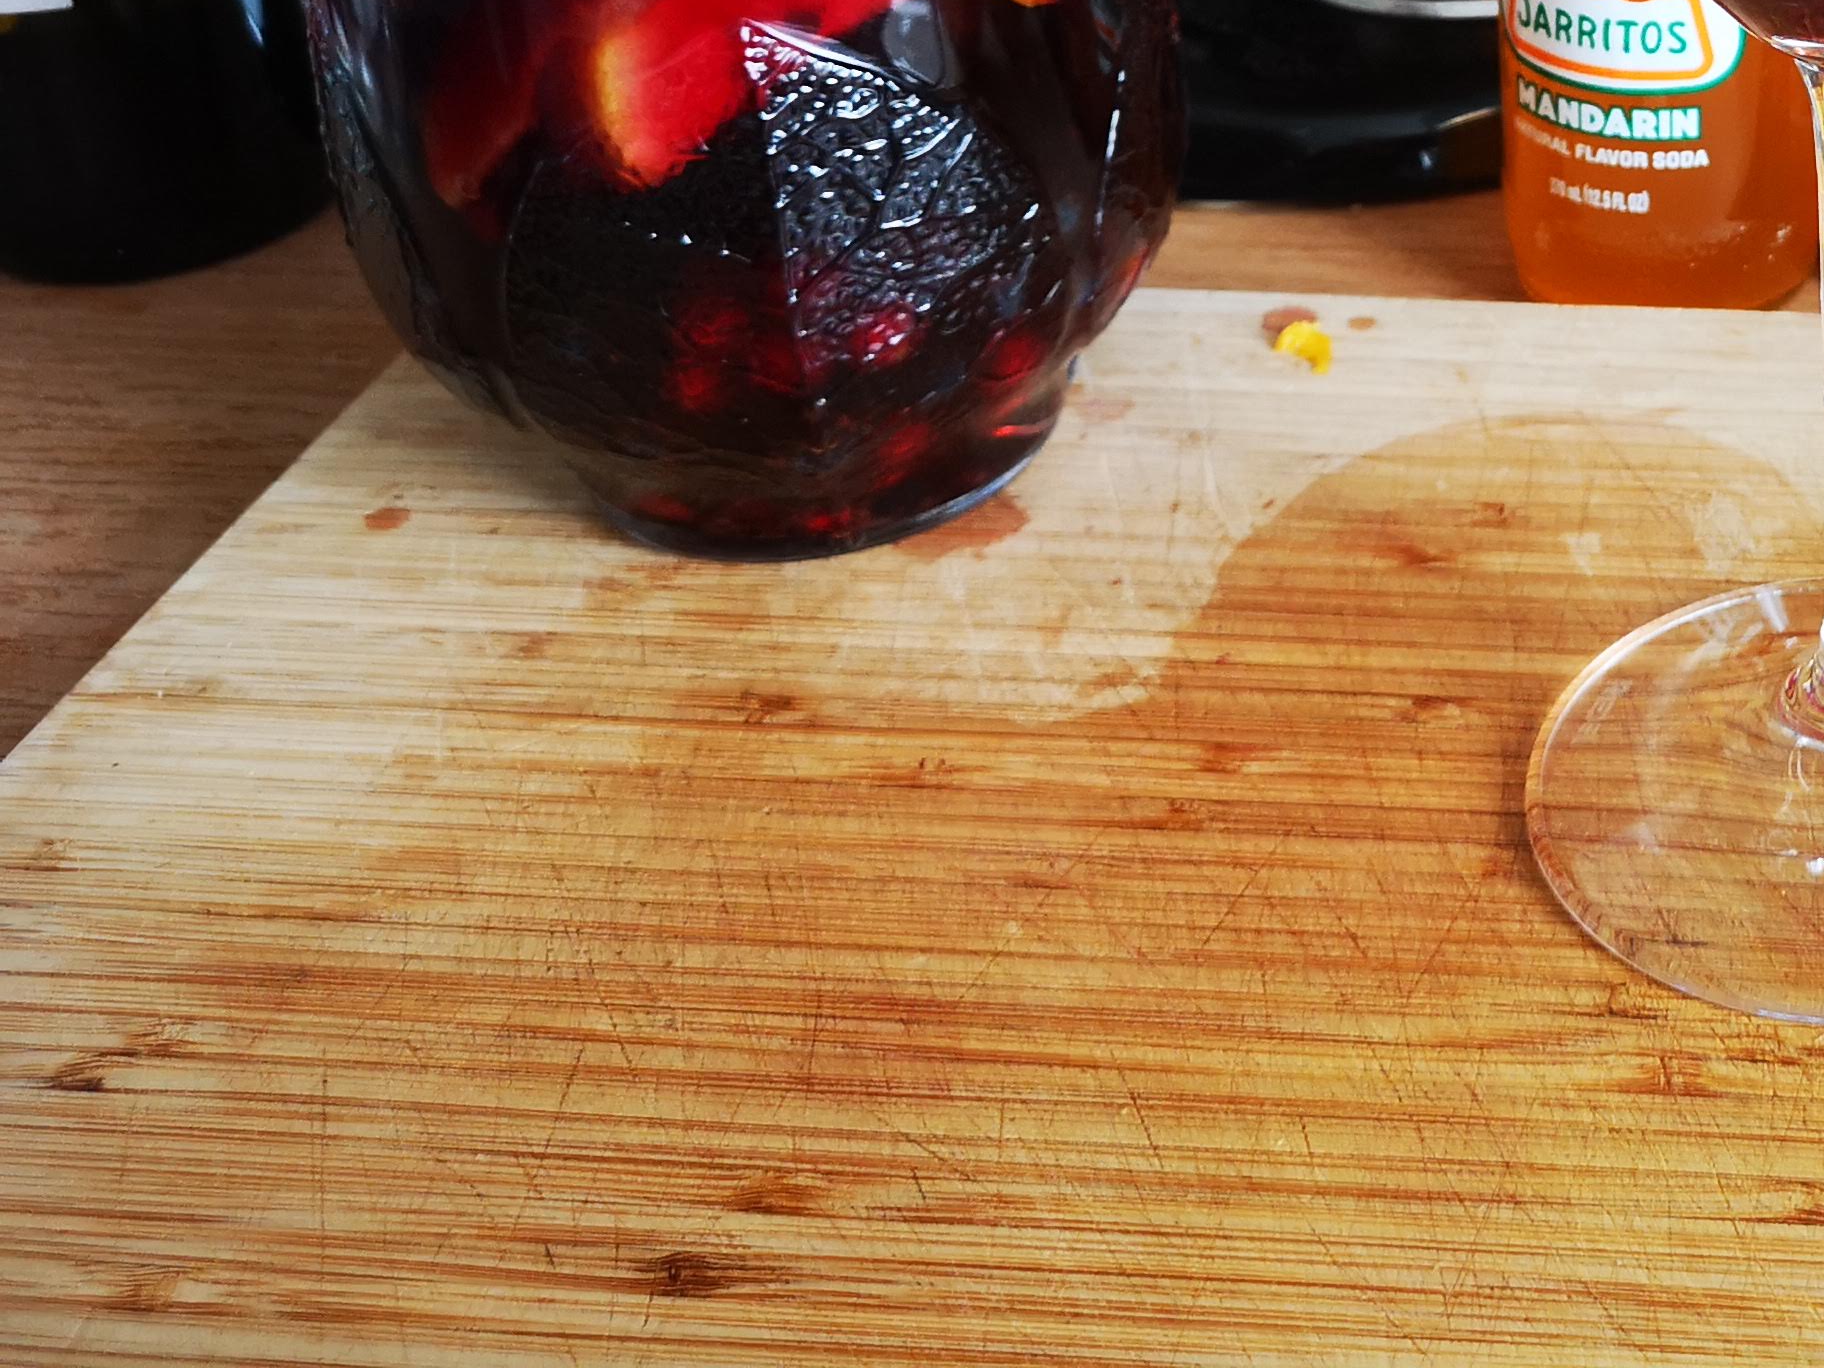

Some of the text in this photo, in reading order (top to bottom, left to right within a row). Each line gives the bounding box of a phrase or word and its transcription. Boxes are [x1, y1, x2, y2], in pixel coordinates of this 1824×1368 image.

[1516, 74, 1702, 143] MANDARIN
[1574, 143, 1649, 170] FLAVOR
[1652, 149, 1711, 170] SODA
